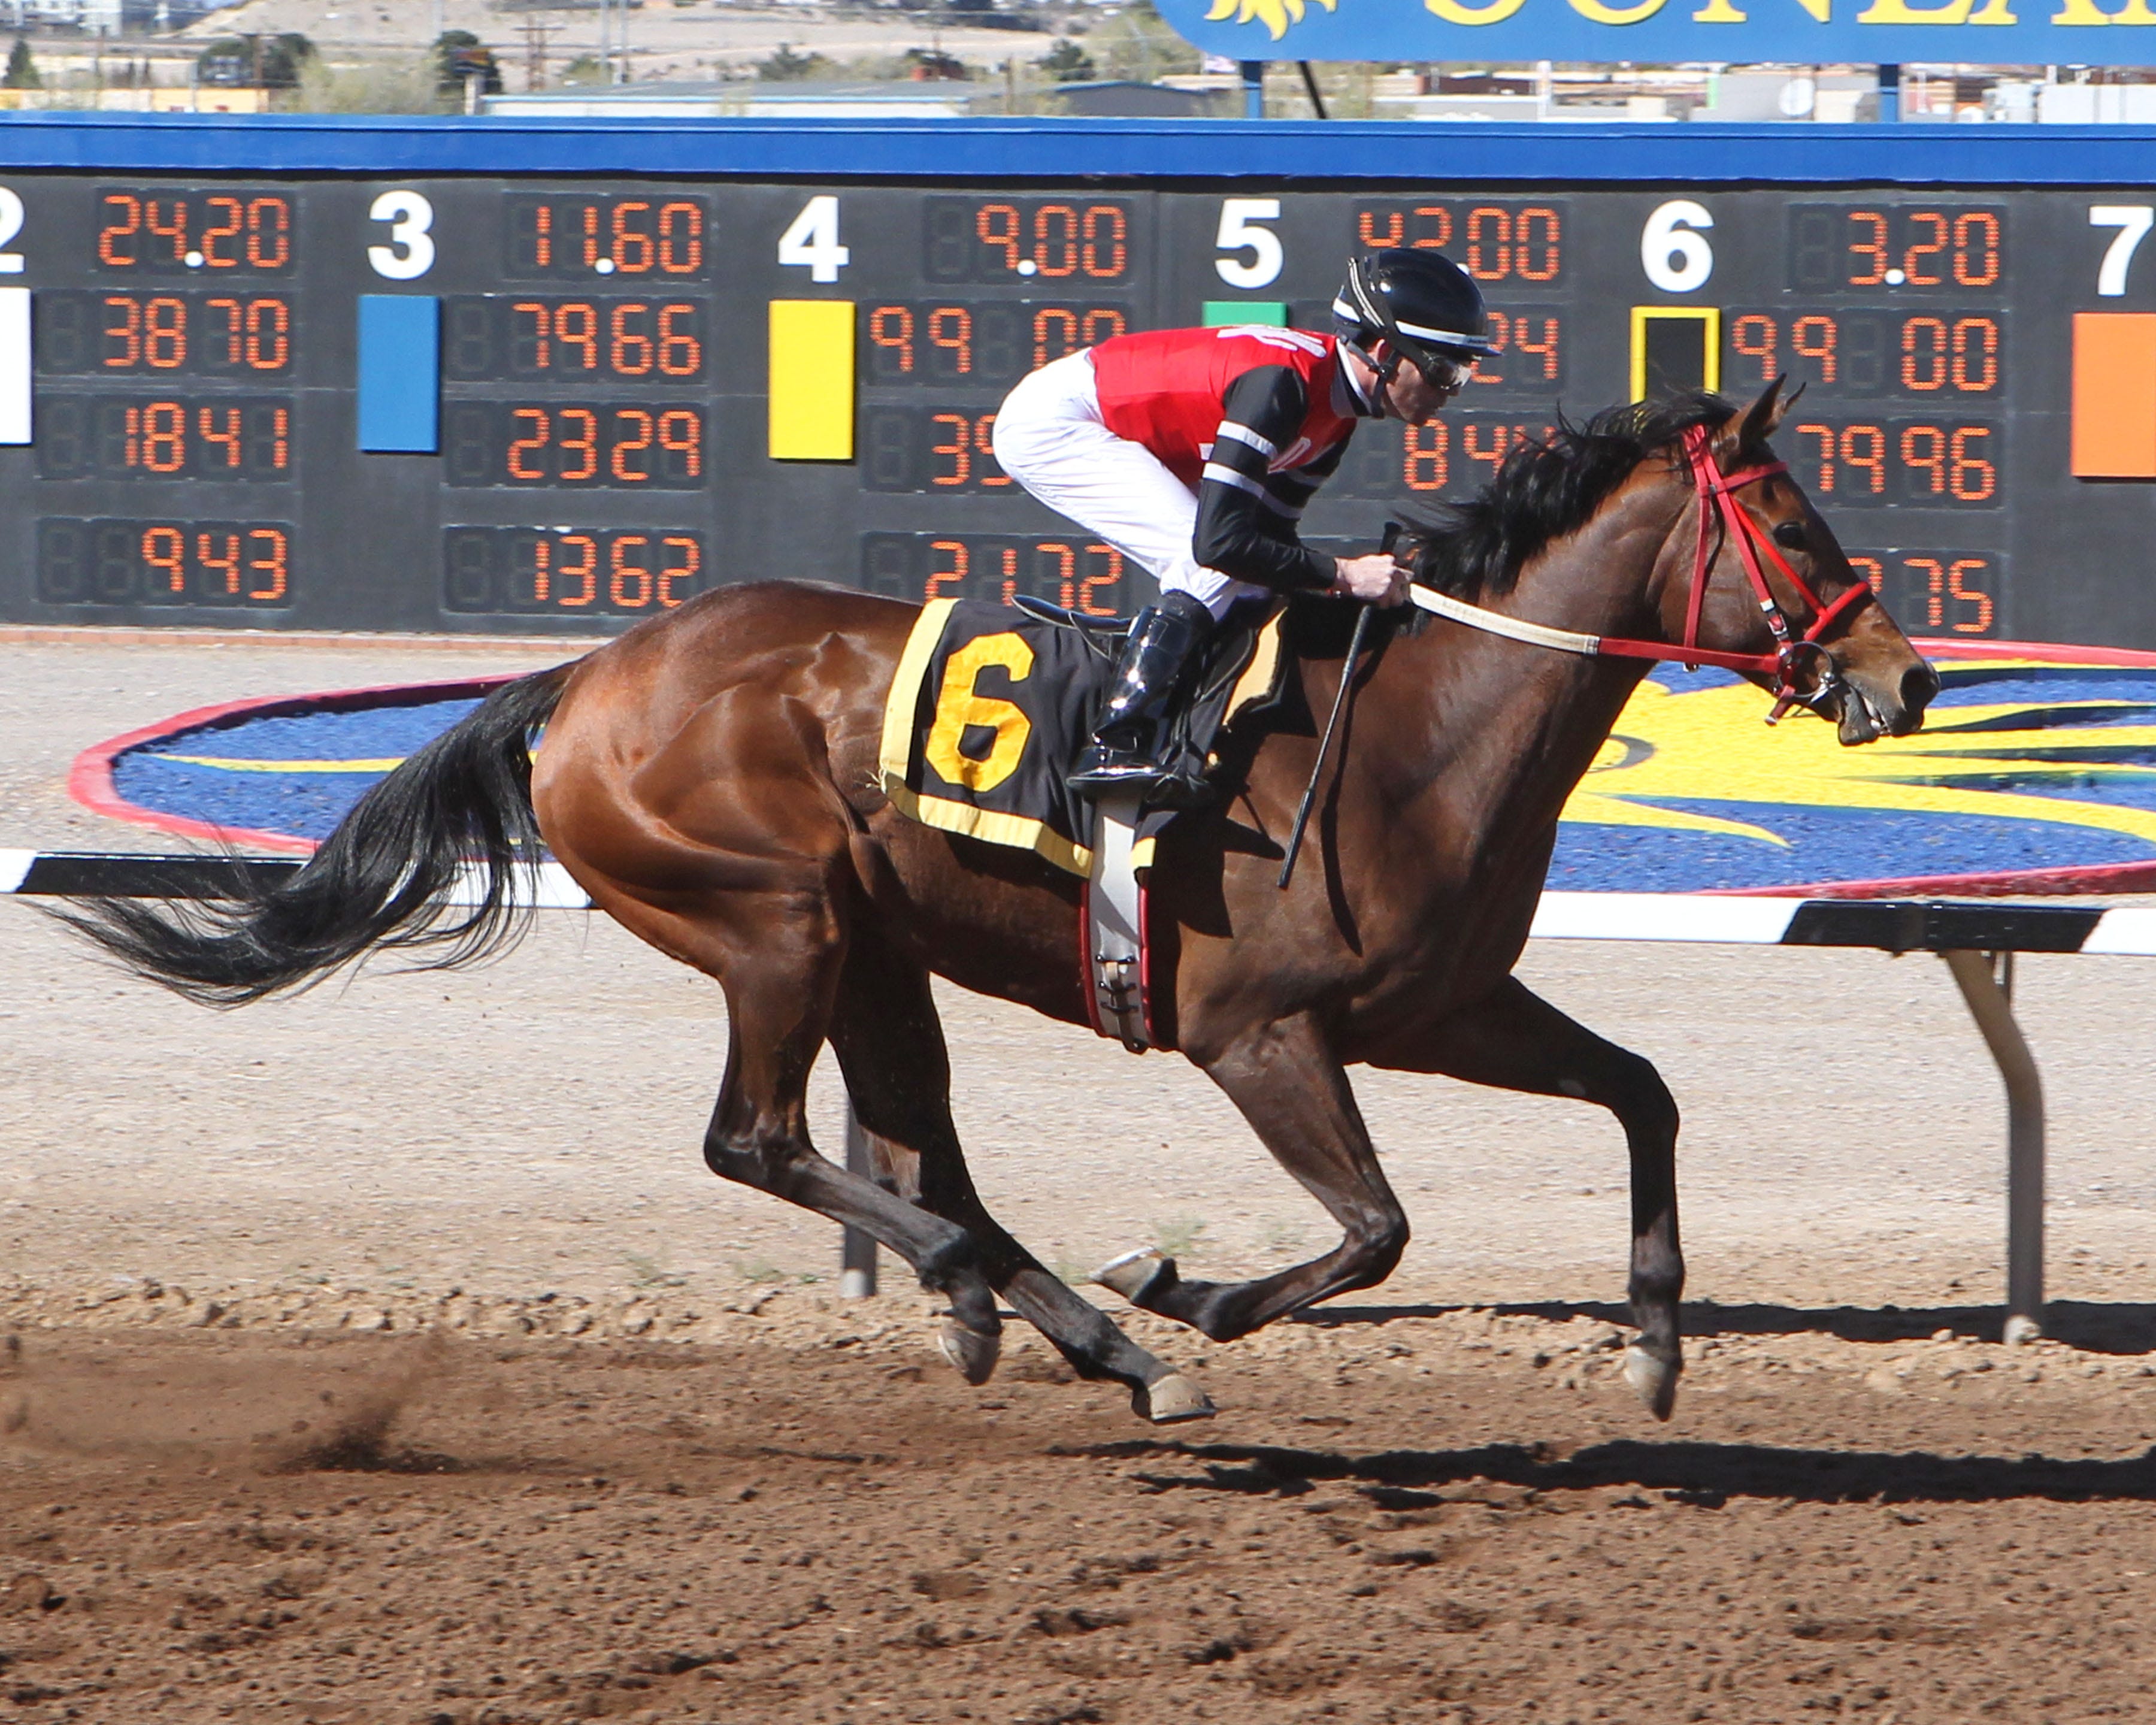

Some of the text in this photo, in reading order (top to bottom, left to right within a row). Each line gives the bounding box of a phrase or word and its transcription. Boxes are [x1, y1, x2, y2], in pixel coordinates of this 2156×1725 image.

[99, 196, 288, 267] 24.20
[369, 192, 433, 278] 3
[537, 202, 701, 273] 11.60
[780, 197, 847, 281] 4
[977, 205, 1125, 276] 9.00
[1216, 200, 1282, 287] 5
[1642, 201, 1712, 290] 6
[1849, 212, 1998, 285] 3.20
[2091, 207, 2153, 294] 7
[926, 632, 1034, 791] 6
